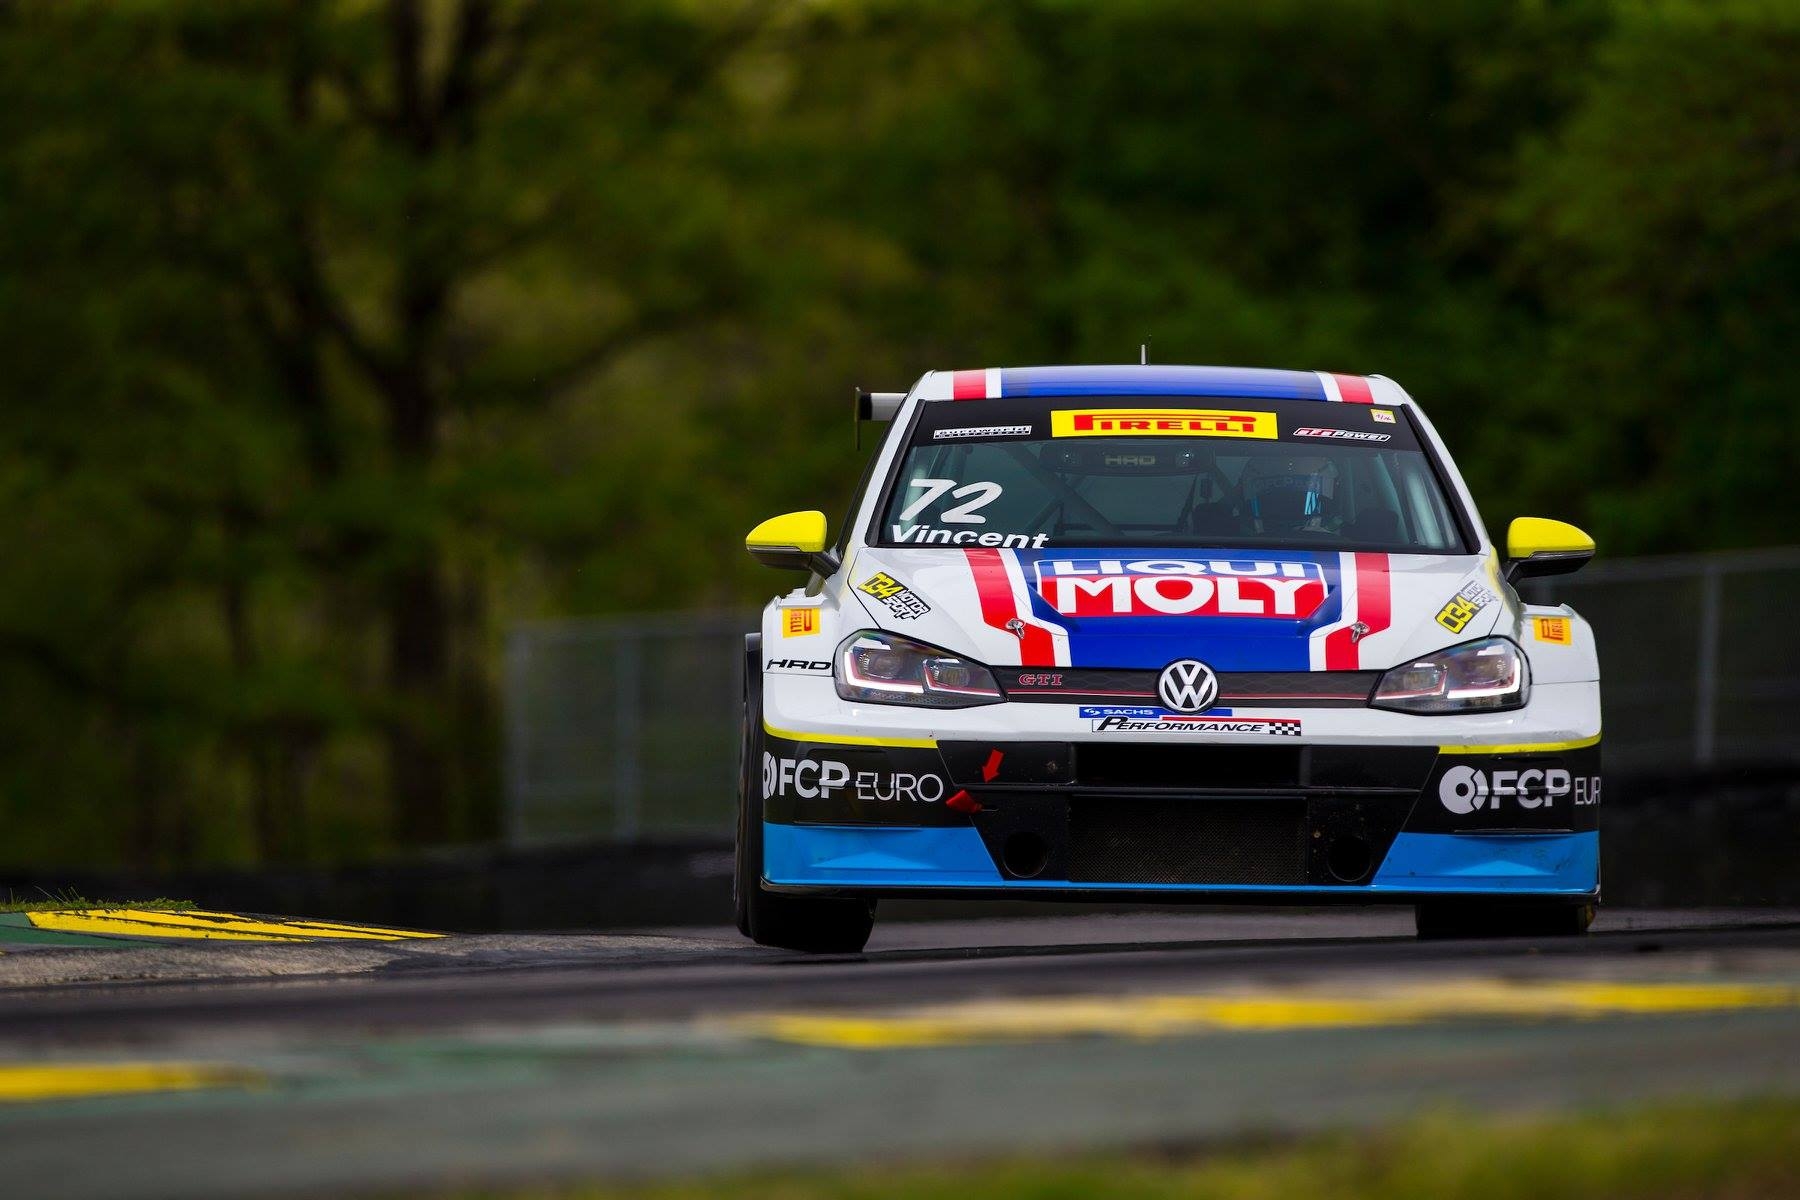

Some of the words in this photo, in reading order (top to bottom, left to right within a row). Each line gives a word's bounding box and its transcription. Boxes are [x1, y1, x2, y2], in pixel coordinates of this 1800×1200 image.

[1074, 414, 1257, 433] PIRELLI
[900, 479, 1003, 524] 72
[892, 525, 1049, 548] Vincent
[1053, 561, 1306, 577] LIQUI
[1056, 576, 1319, 615] MOLY
[1436, 595, 1480, 634] 034
[766, 659, 831, 670] HRD
[1018, 673, 1062, 686] GTI
[1158, 659, 1219, 712] VW
[1099, 716, 1265, 732] PERFORMANCE
[779, 758, 850, 799] FCP
[855, 771, 944, 802] EURO
[1490, 768, 1571, 809] FCP
